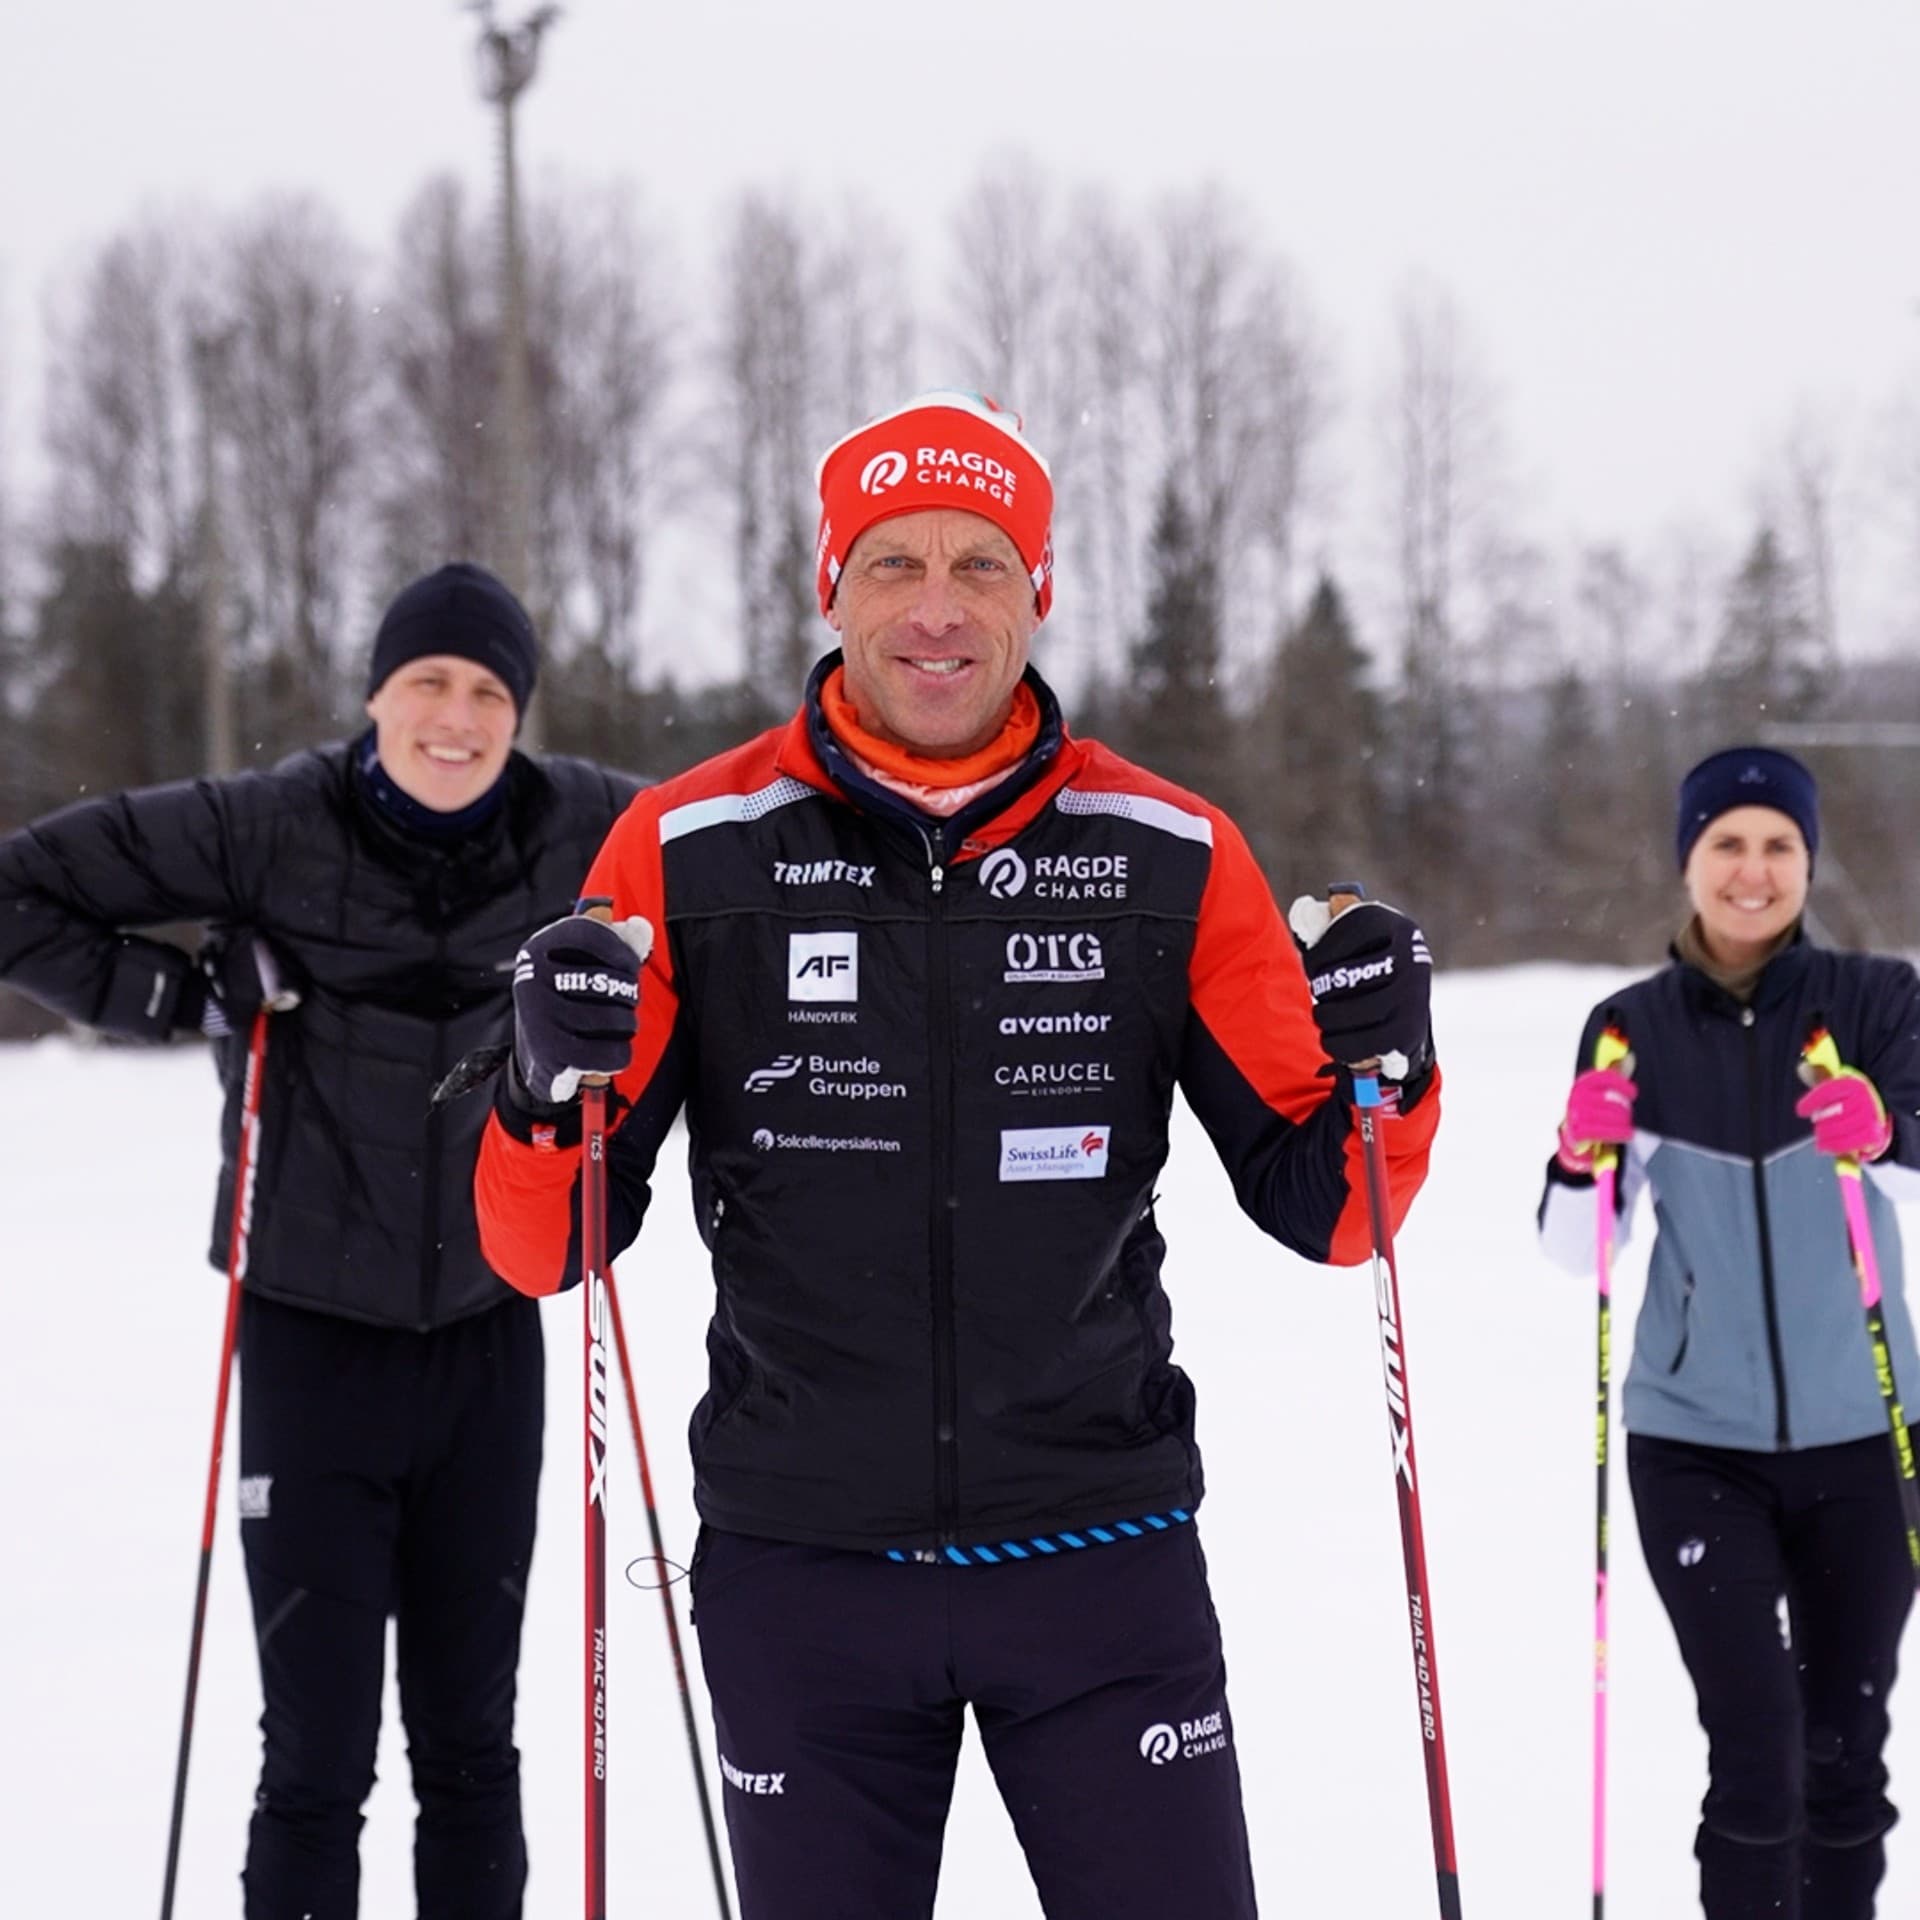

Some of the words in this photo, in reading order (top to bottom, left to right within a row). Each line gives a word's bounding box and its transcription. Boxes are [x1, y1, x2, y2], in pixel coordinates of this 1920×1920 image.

[916, 447, 1017, 491] RAGDE
[916, 469, 1014, 508] CHARGE
[774, 860, 876, 887] TRIMTEX
[1035, 855, 1128, 879] RAGDE
[1035, 882, 1127, 900] CHARGE
[1006, 933, 1102, 970] OTG
[796, 956, 850, 978] AF
[999, 1012, 1112, 1034] avantor
[809, 1055, 881, 1074] Bunde
[994, 1063, 1115, 1085] CARUCEL
[809, 1077, 907, 1100] Gruppen
[590, 1133, 603, 1161] TCS
[1008, 1144, 1078, 1161] SwissLife
[593, 1628, 605, 1689] TRIAC
[1411, 1594, 1426, 1653] TRIAC
[1420, 1684, 1436, 1742] AERO
[593, 1720, 605, 1781] AERO
